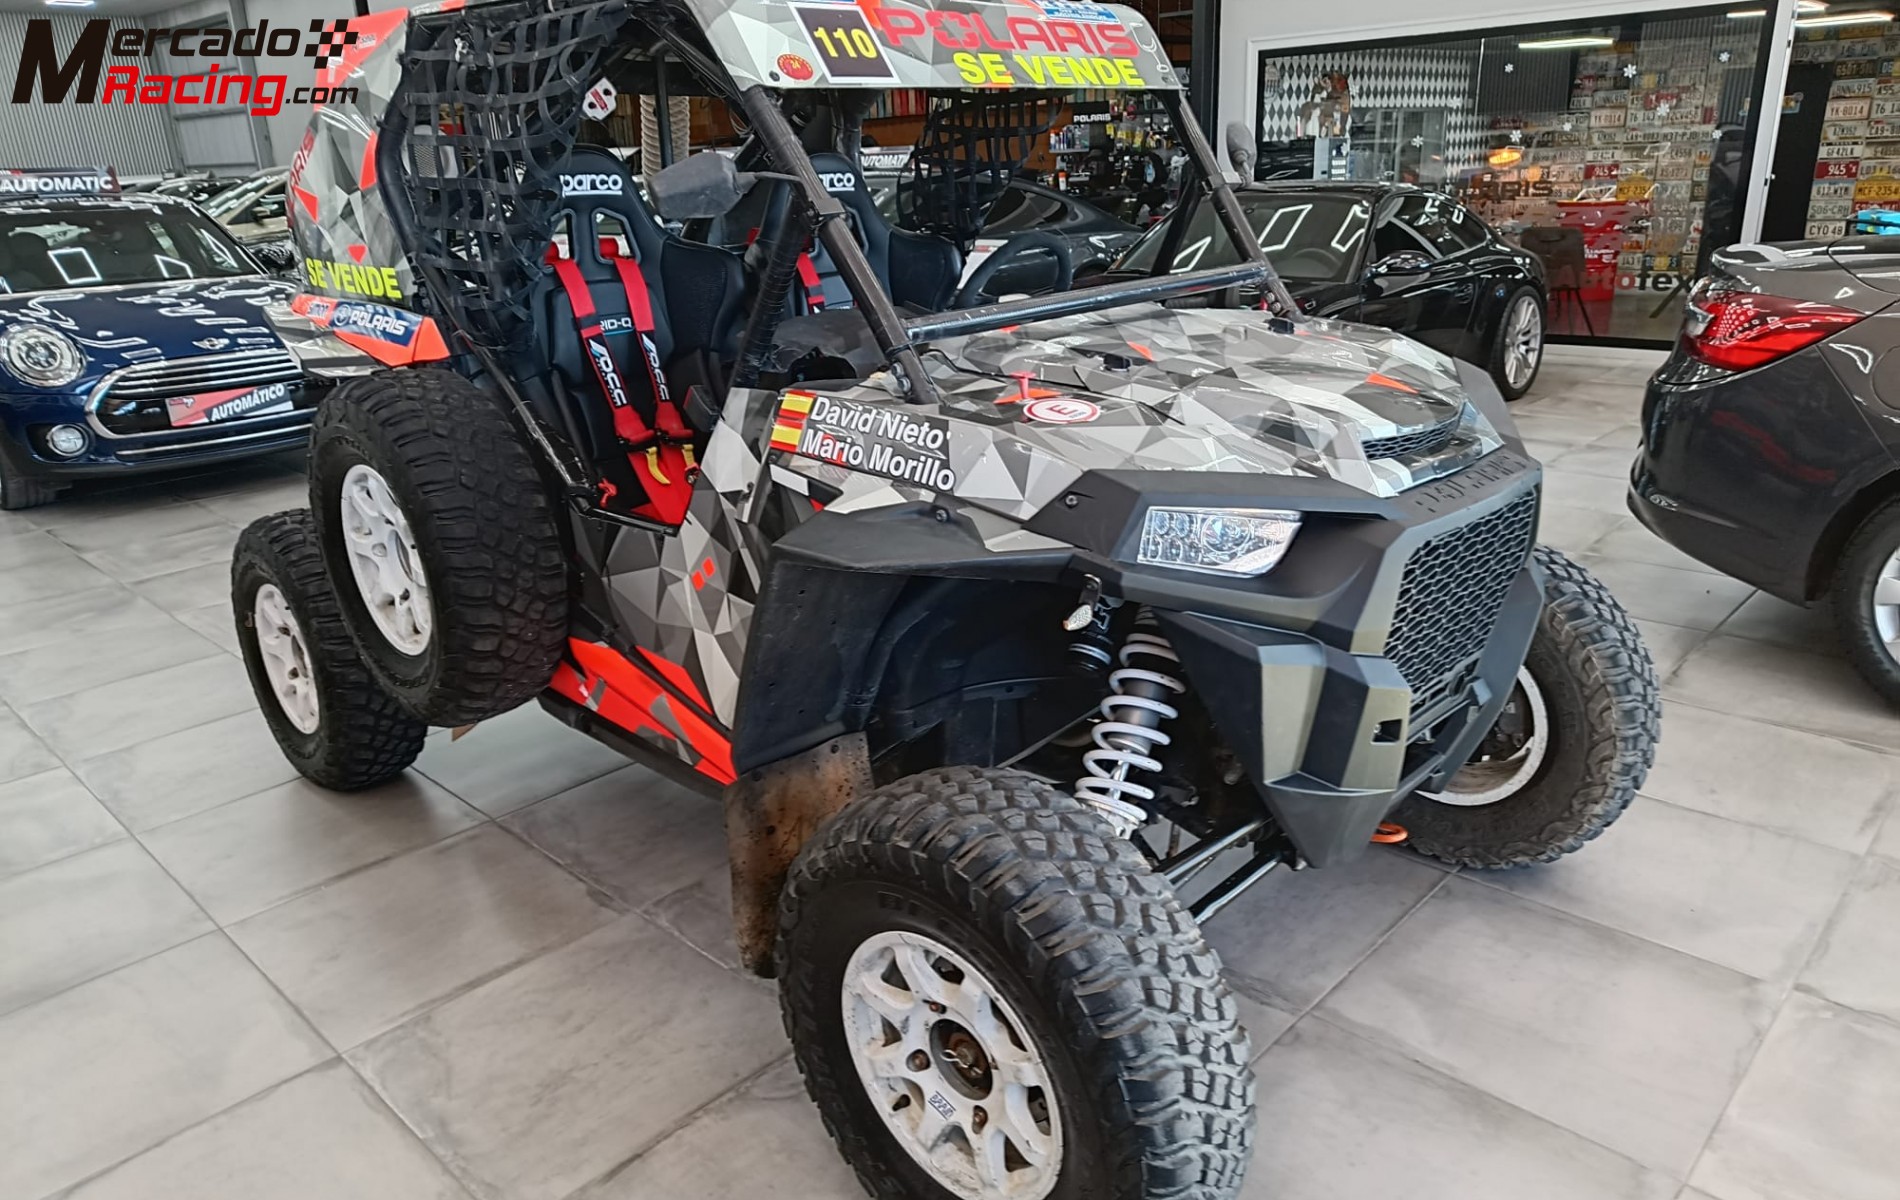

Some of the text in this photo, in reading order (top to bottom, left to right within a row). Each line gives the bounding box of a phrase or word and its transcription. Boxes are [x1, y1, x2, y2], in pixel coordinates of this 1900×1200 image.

[813, 26, 877, 58] 110
[874, 8, 1140, 57] POLARIS
[953, 52, 1146, 86] SE VENDE
[1073, 113, 1112, 123] POLARIS
[559, 174, 623, 198] parco
[1828, 164, 1847, 175] 945
[305, 257, 402, 299] SE VENDE
[349, 310, 411, 336] POLARIS
[211, 383, 286, 422] AUTOMÁTICO
[810, 396, 944, 450] David Nieto
[801, 429, 956, 491] Mario Morillo
